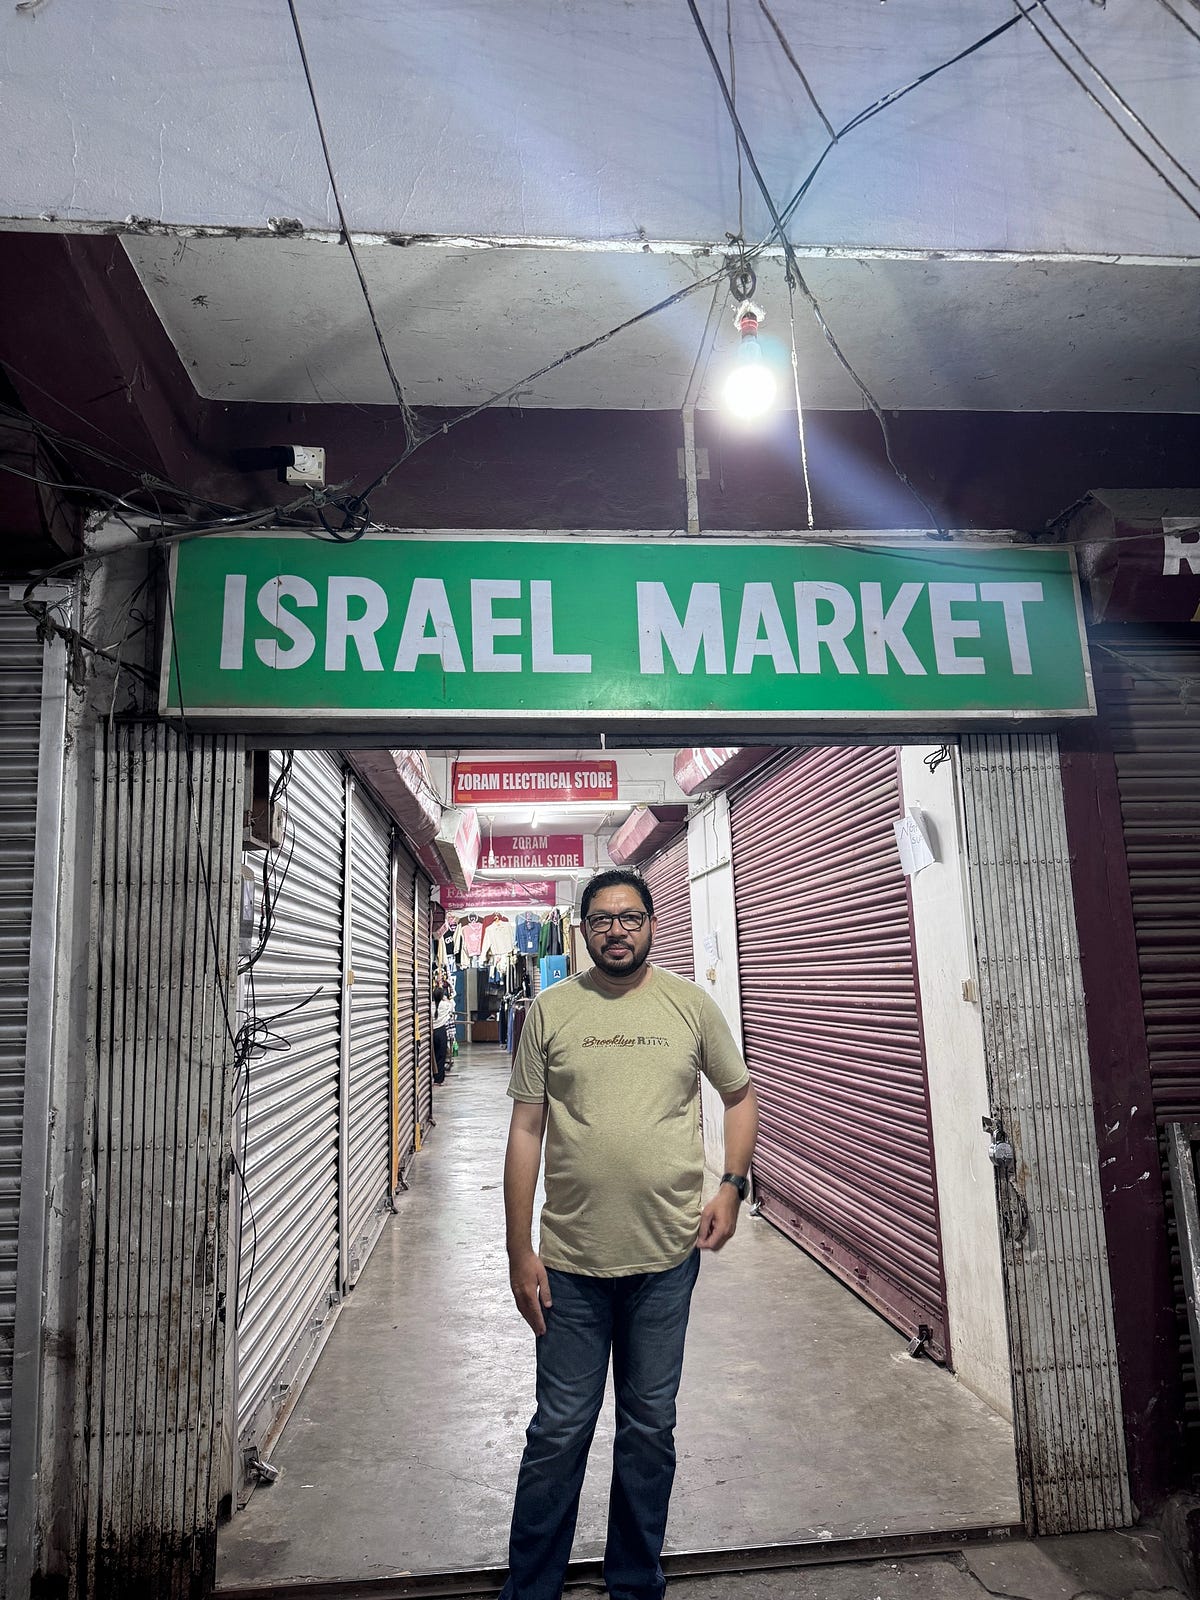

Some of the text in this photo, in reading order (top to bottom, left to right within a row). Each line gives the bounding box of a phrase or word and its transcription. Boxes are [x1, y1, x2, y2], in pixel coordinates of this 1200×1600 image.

[220, 574, 1044, 675] ISRAEL MARKET
[457, 771, 613, 791] ZORAM ELECTRICAL STORE
[512, 836, 548, 850] ZORAM
[481, 853, 579, 869] EECTRICAL STORE
[582, 1035, 636, 1048] Brooklyn
